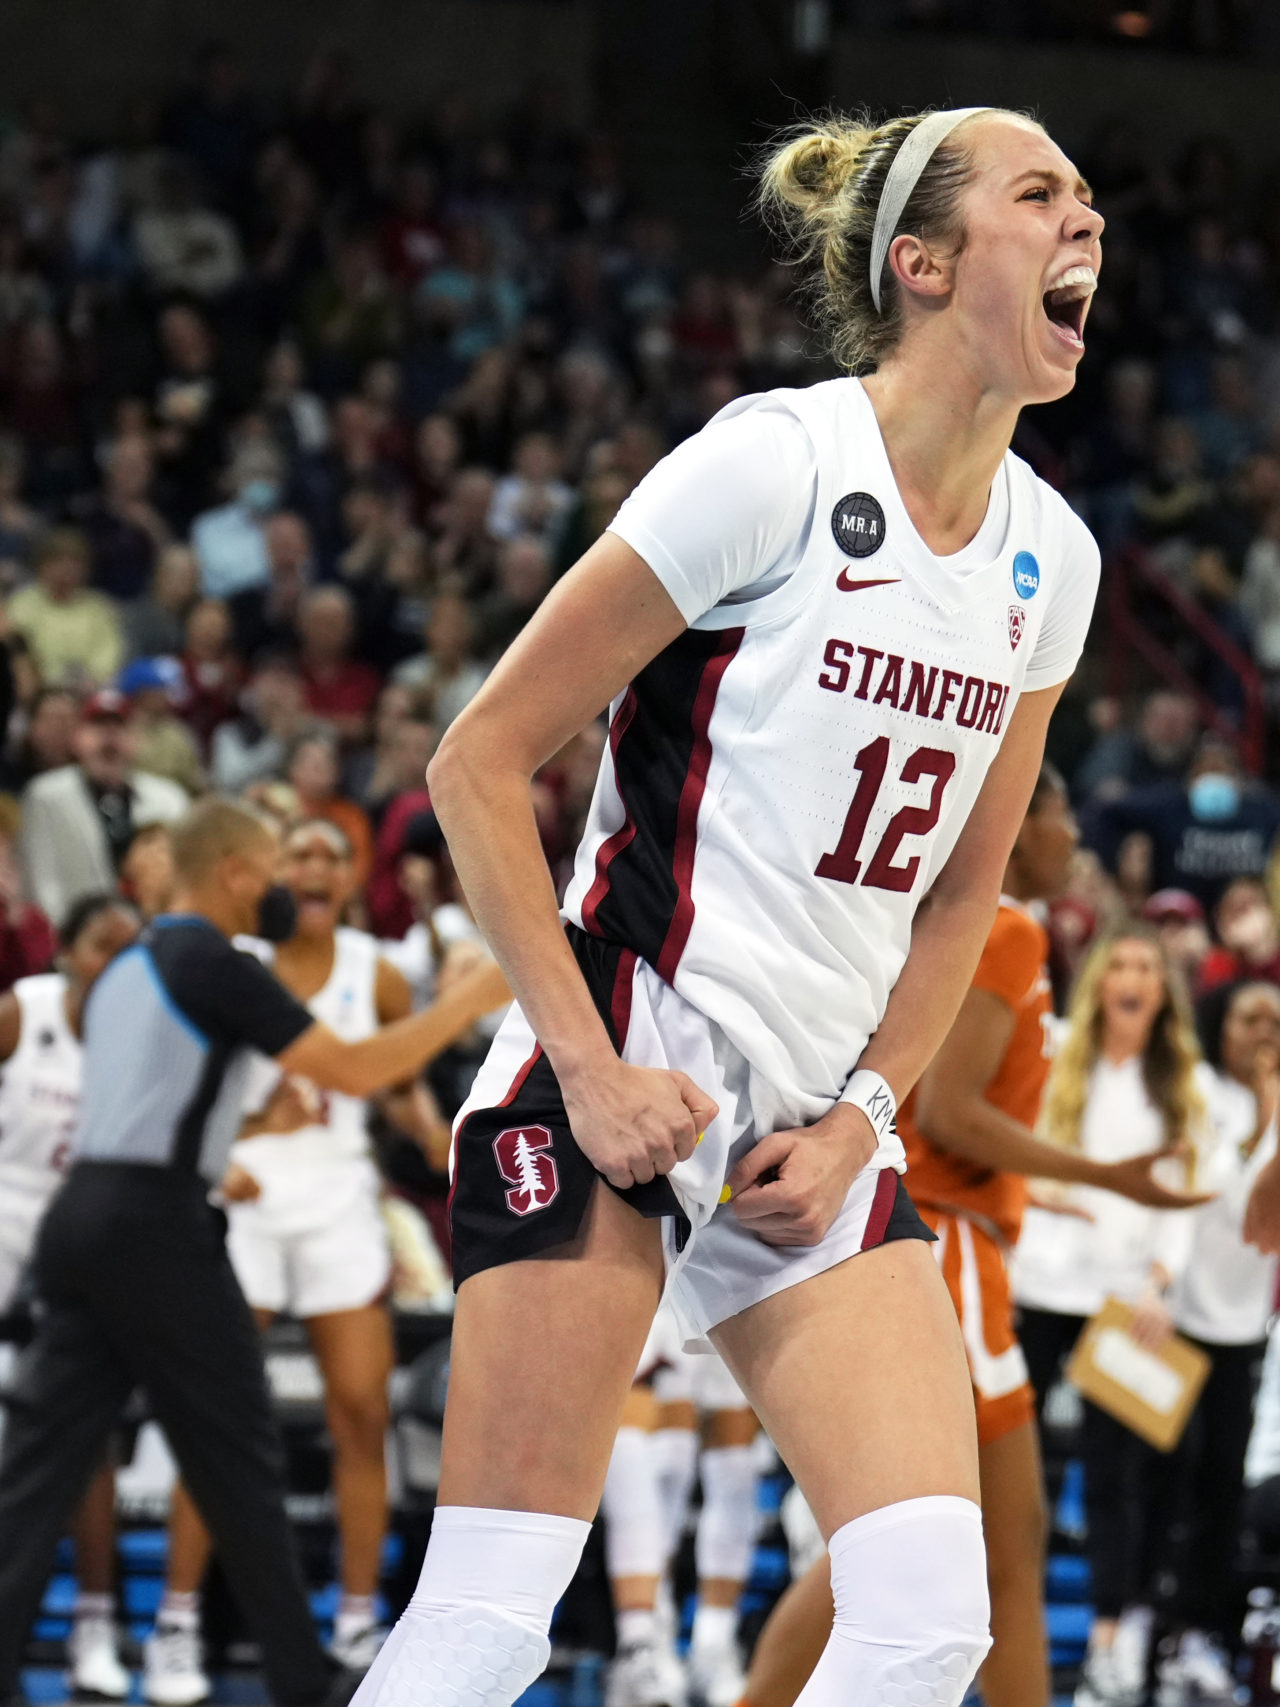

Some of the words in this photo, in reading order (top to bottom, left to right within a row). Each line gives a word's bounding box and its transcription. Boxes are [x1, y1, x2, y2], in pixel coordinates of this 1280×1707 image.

[841, 514, 878, 536] MR.A
[1017, 571, 1039, 589] NCAA
[814, 736, 956, 893] 12
